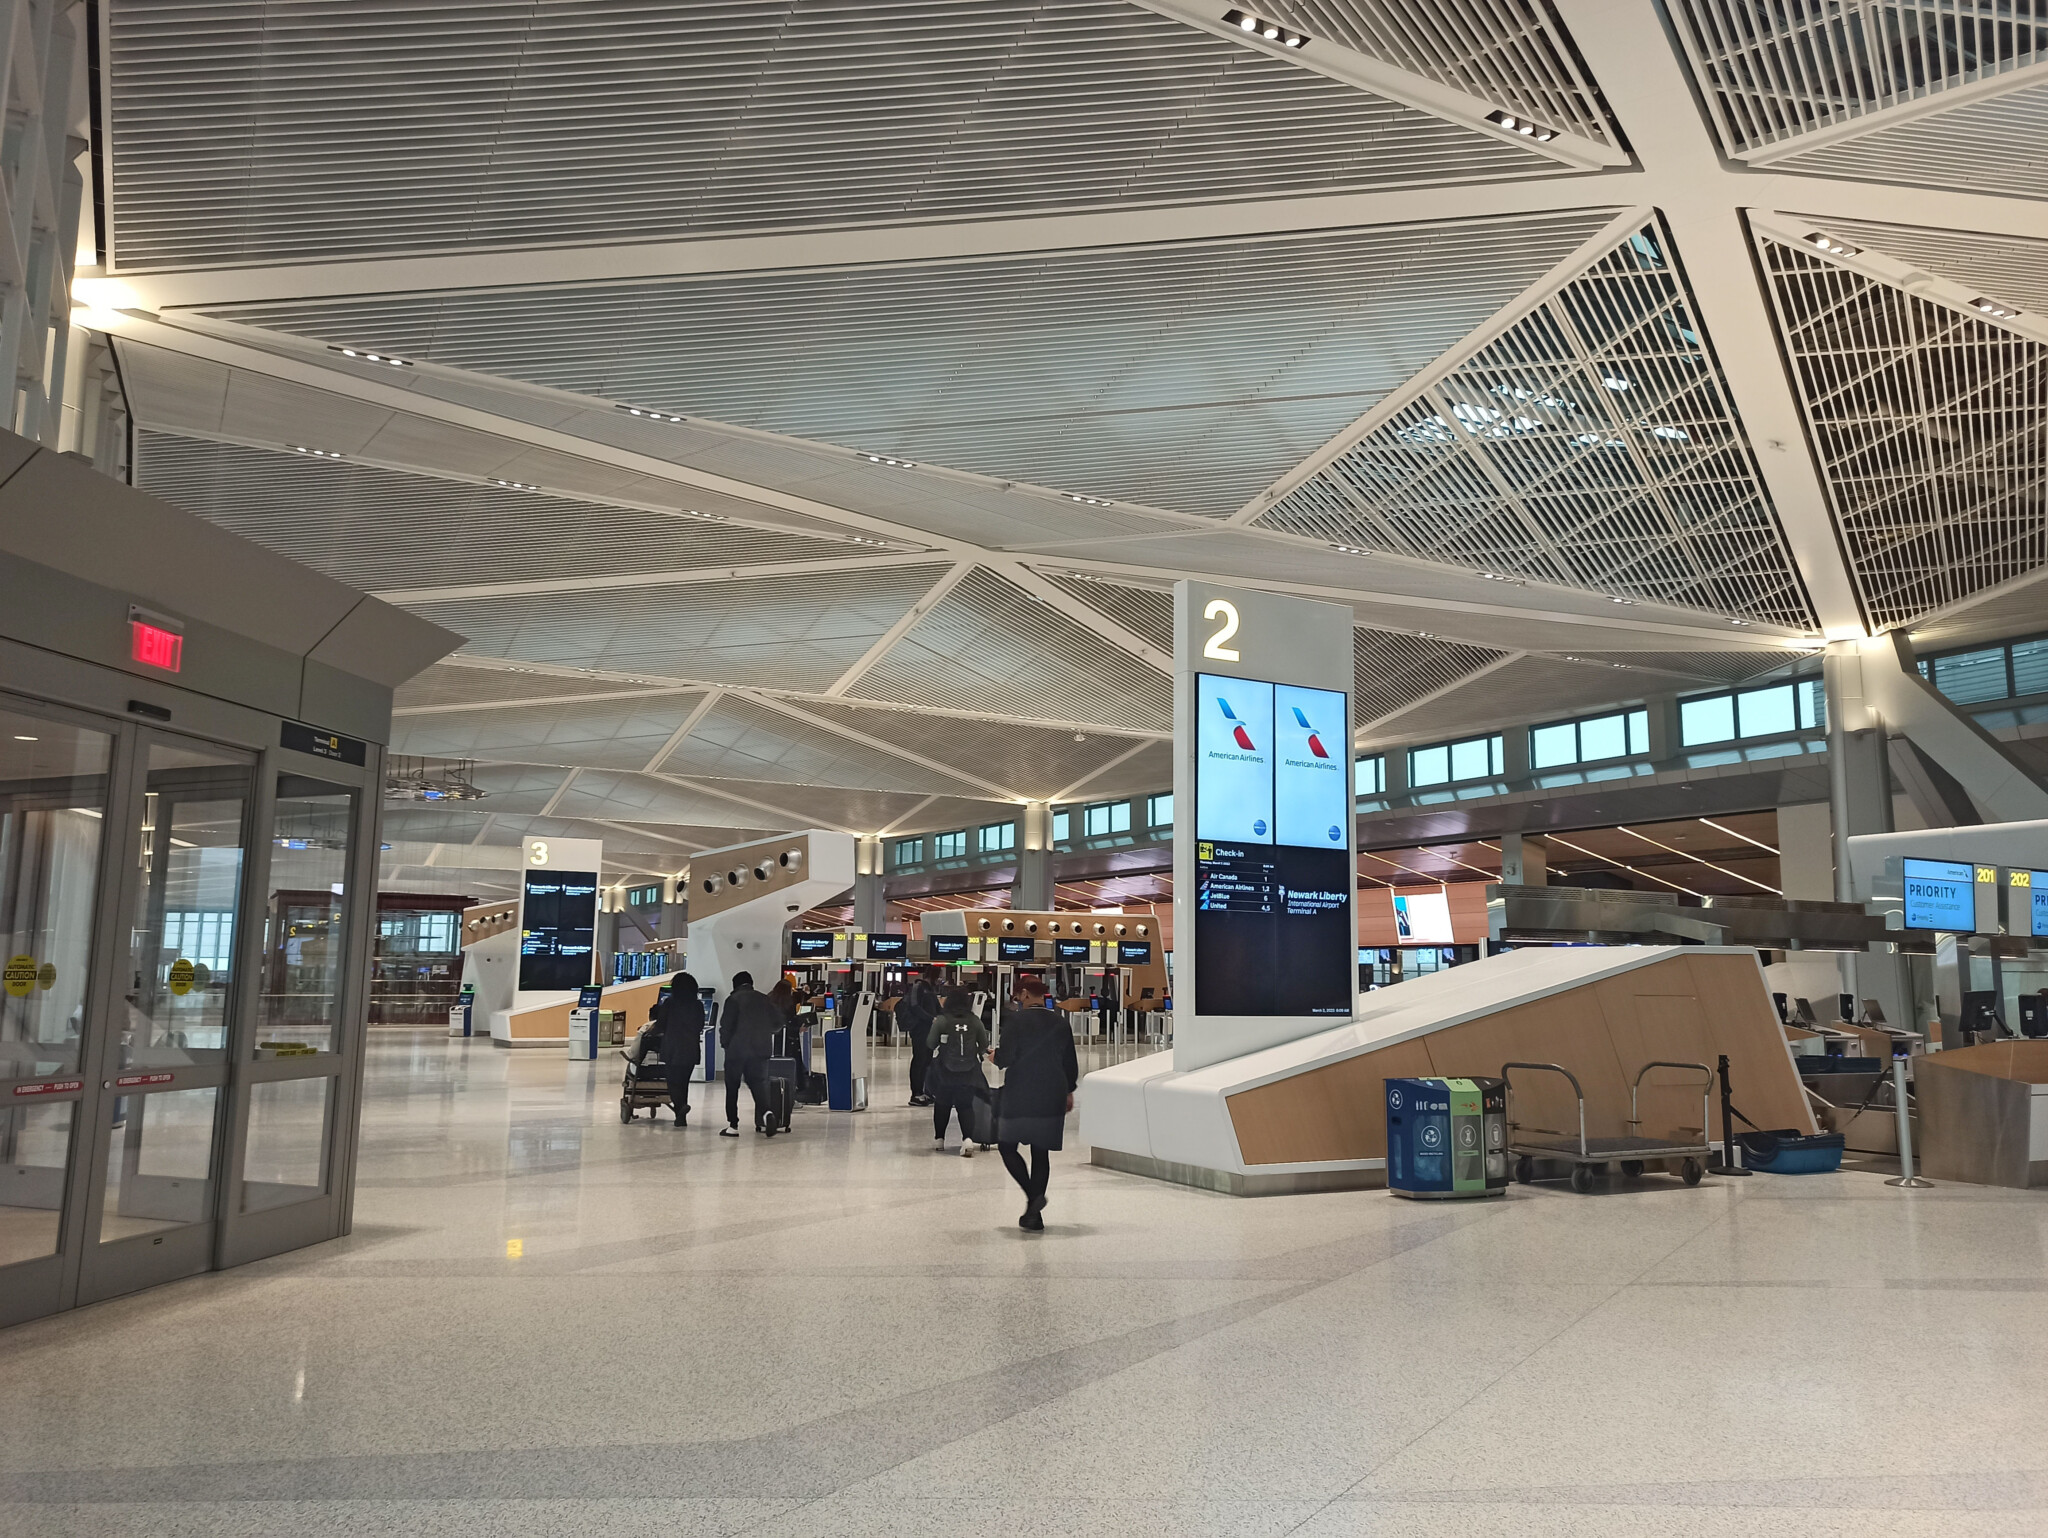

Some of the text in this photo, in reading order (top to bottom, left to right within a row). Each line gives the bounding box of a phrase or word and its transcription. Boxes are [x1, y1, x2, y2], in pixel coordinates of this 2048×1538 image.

[1203, 599, 1240, 662] 2
[141, 626, 175, 667] EXIT
[1208, 750, 1264, 764] American Airlines
[1285, 759, 1337, 771] American Airlines
[530, 841, 549, 866] 3
[1215, 848, 1245, 857] Check-in
[1977, 868, 1995, 883] 201
[2010, 872, 2030, 887] 202
[1287, 890, 1347, 903] Newark Liberty
[1910, 884, 1956, 899] PRIORITY
[1287, 900, 1322, 908] International
[1287, 907, 1312, 915] Terminal
[5, 971, 35, 980] CAUTION
[171, 973, 194, 981] CAUTION
[21, 1084, 44, 1093] EMERGENCY
